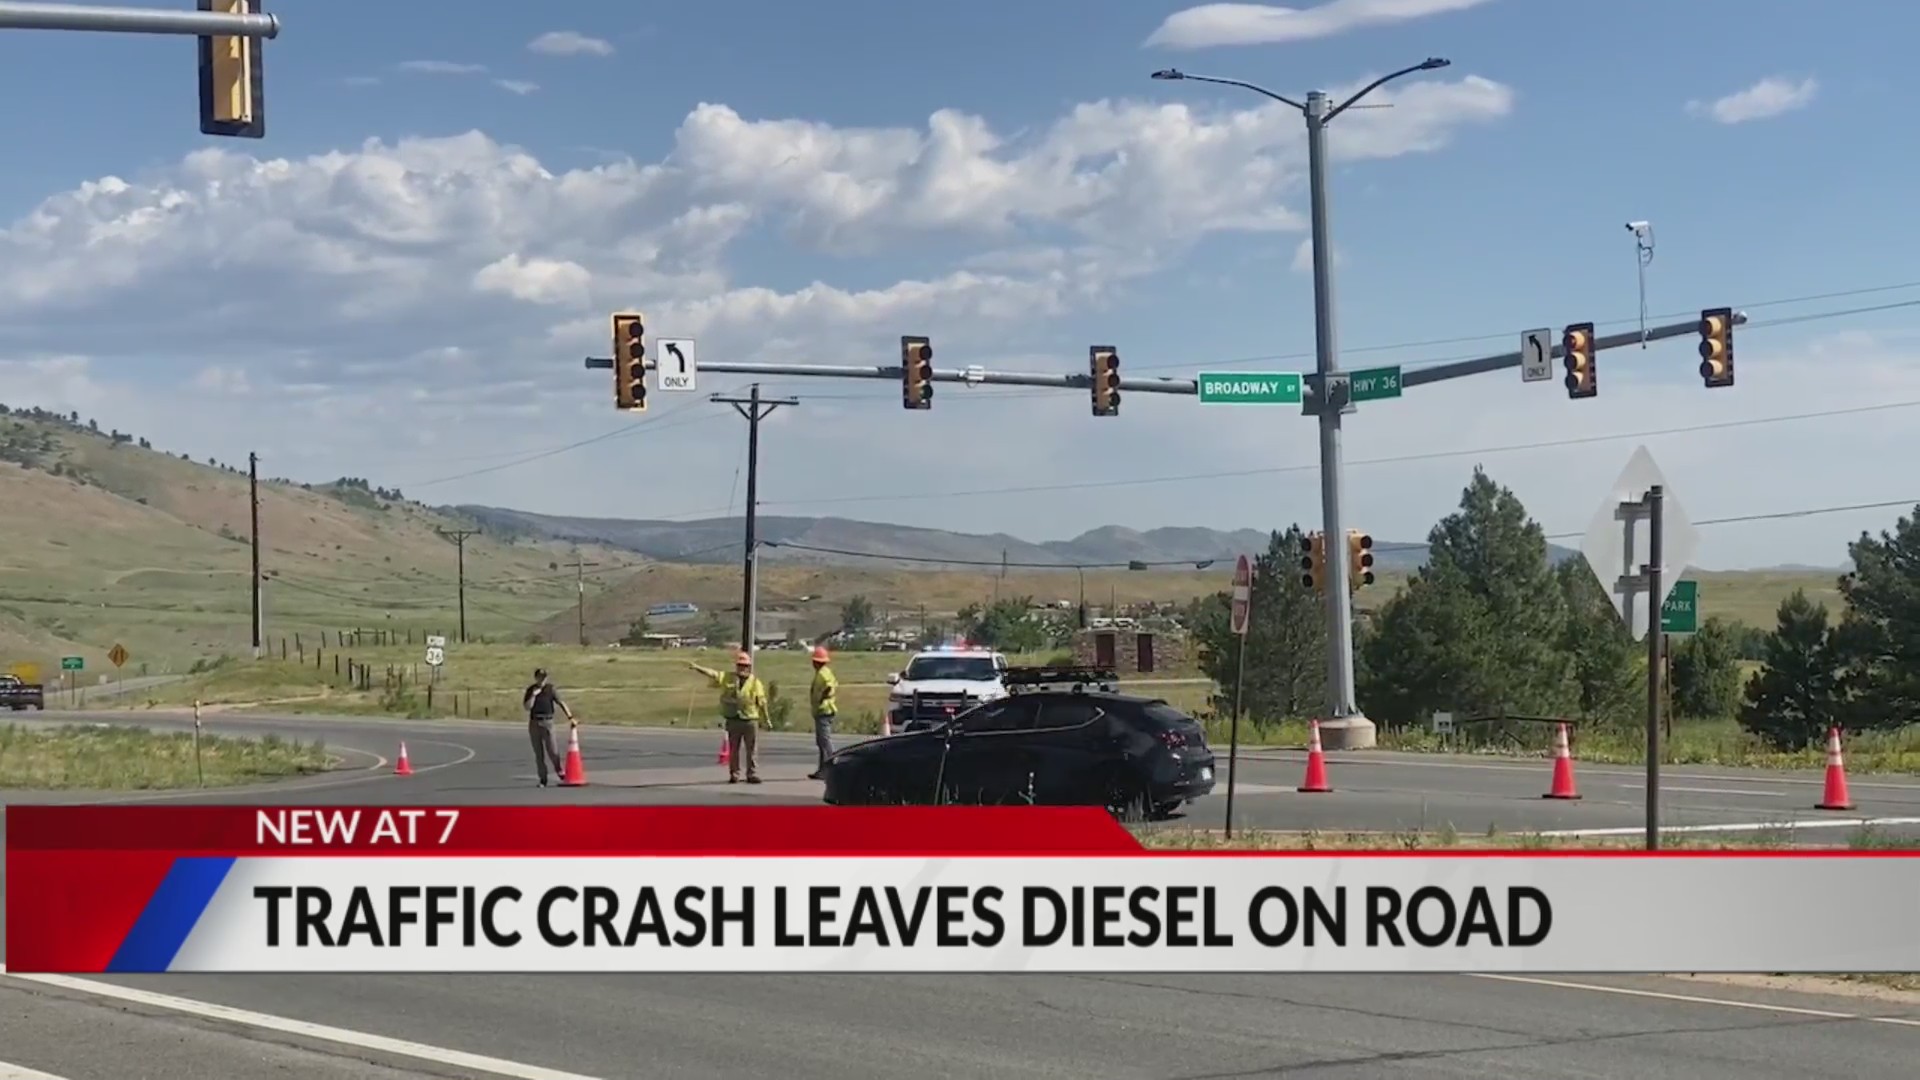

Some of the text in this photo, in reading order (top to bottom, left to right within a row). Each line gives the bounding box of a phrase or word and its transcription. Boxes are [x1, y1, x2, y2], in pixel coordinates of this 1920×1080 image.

[664, 376, 689, 387] ONLY
[1353, 375, 1397, 392] HWY 36
[1205, 381, 1279, 395] BROADWAY
[1664, 600, 1691, 611] PARK
